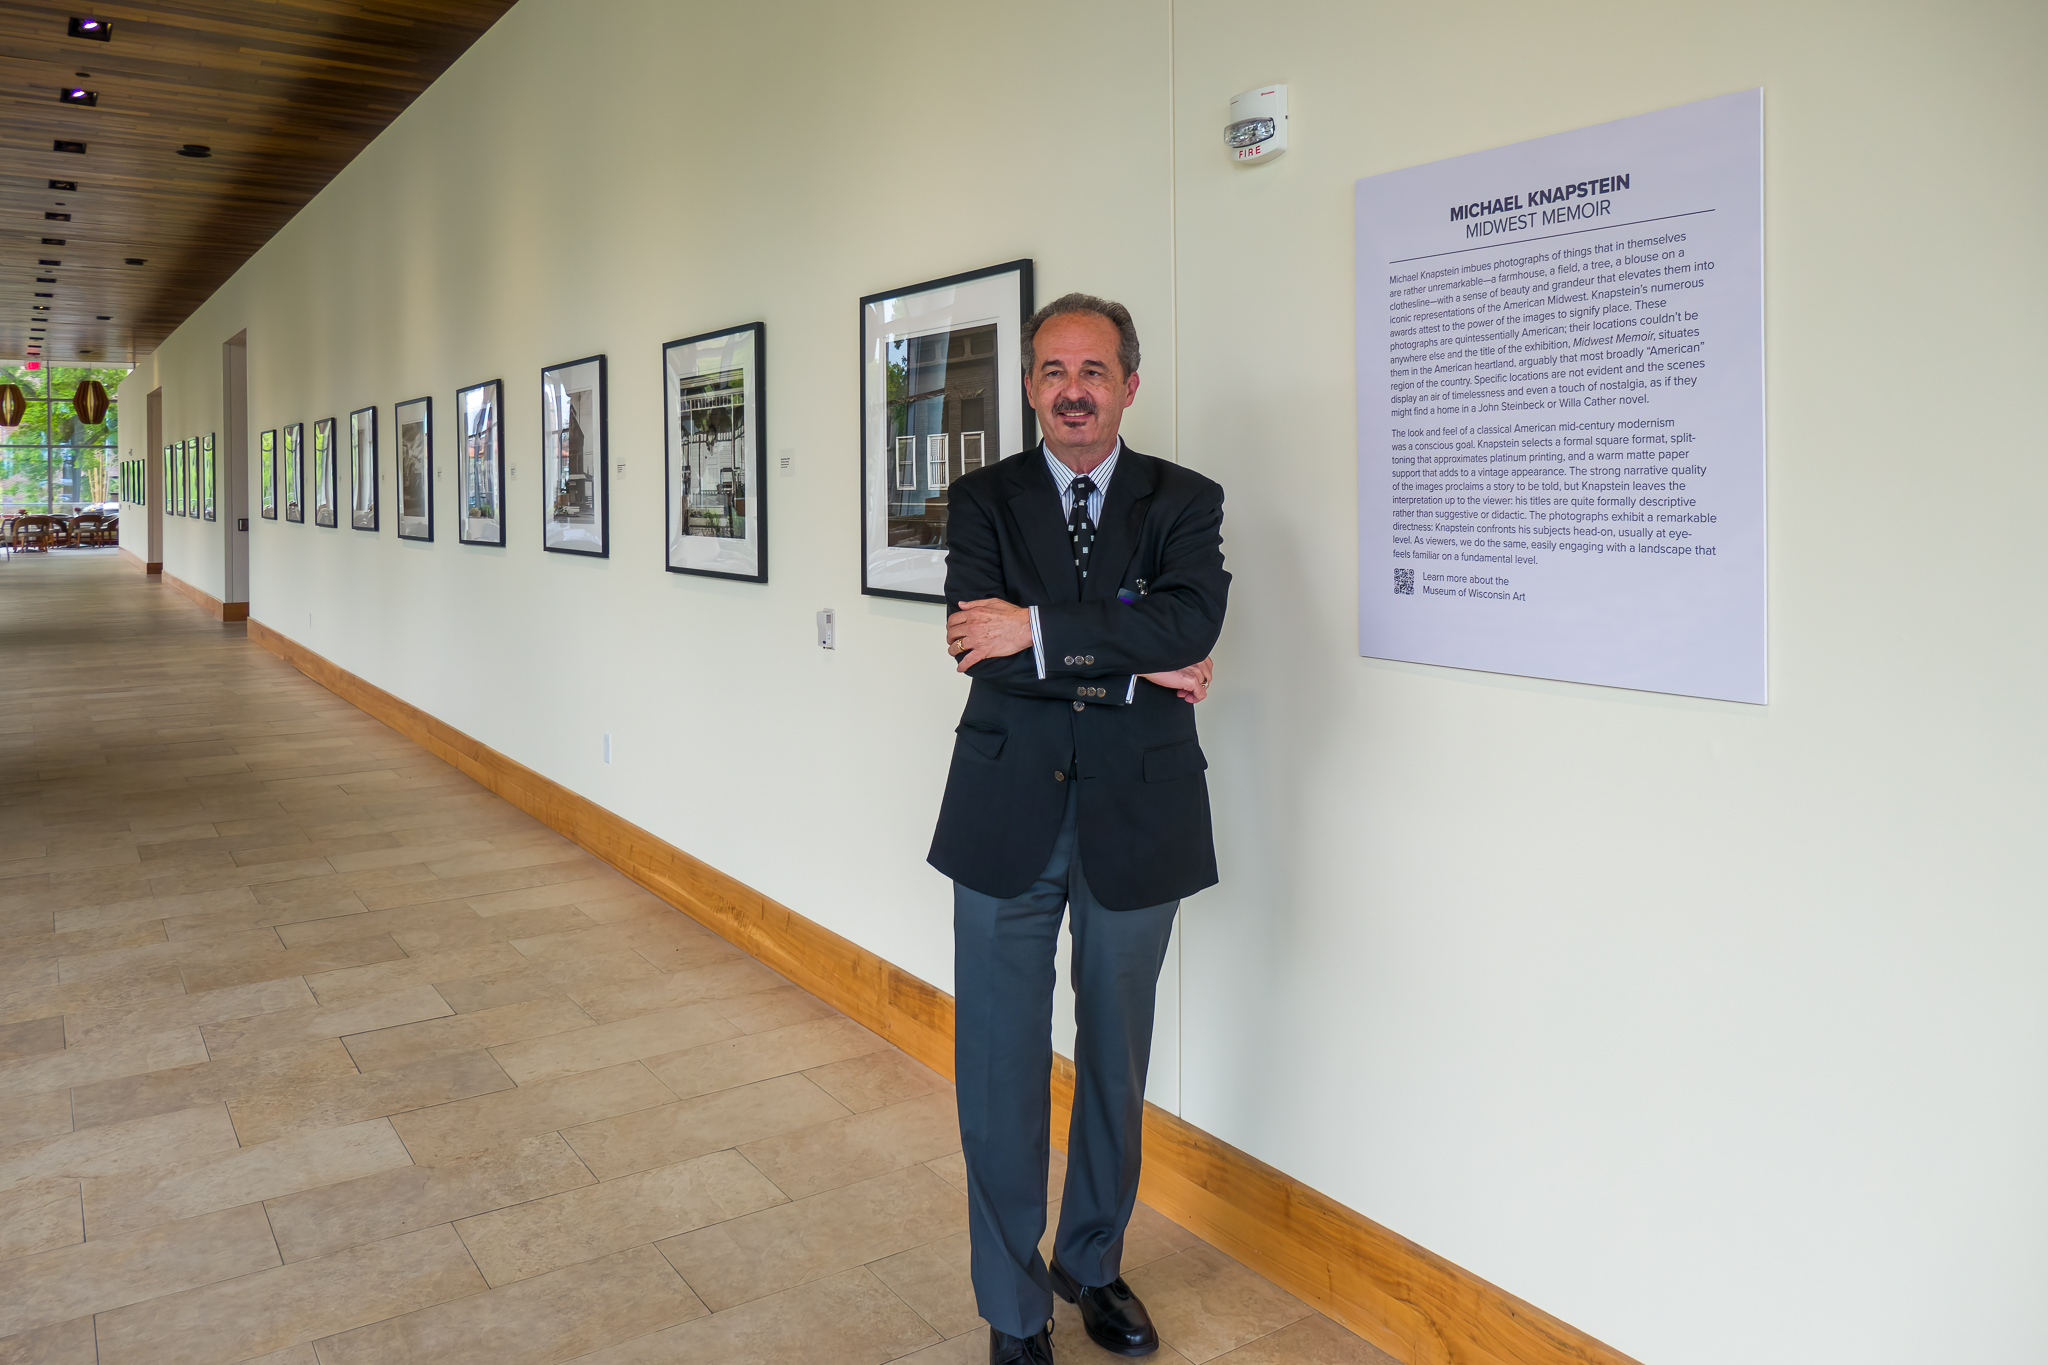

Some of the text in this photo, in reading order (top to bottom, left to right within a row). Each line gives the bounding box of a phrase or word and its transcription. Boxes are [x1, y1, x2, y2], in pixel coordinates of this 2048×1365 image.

[1238, 145, 1261, 158] FIRE
[1450, 173, 1630, 222] MICHAEL KNAPSTEIN
[1466, 199, 1611, 239] MIDWEST MEMOIR
[1389, 233, 1687, 284] Michael Knapstein imbues photographs things that themselves
[1403, 285, 1426, 296] rather
[1498, 269, 1547, 282] farmhouse,
[1557, 262, 1580, 274] field,
[1590, 260, 1613, 270] tree,
[1624, 253, 1659, 265] blouse
[1462, 291, 1488, 302] sense
[1500, 285, 1530, 297] beauty
[1551, 277, 1595, 292] grandeur
[1596, 273, 1616, 284] that
[1618, 268, 1661, 281] elevates
[1664, 264, 1691, 276] them
[1694, 261, 1715, 272] into
[1389, 313, 1412, 324] iconic
[1413, 307, 1475, 322] representations
[1502, 298, 1545, 311] American
[1547, 292, 1589, 305] Midwest.
[1650, 279, 1704, 293] numerous
[1389, 299, 1667, 338] awards attest power images signify place. These
[1390, 338, 1438, 352] photographs
[1454, 329, 1520, 346] quintessentially
[1521, 325, 1567, 337] American;
[1569, 321, 1591, 332] their
[1593, 318, 1637, 330] locations
[1390, 328, 1700, 365] anywhere else title exhibition, Midwest Memoir, situates
[1390, 368, 1410, 377] them
[1434, 363, 1472, 374] American
[1474, 358, 1517, 370] heartland,
[1518, 354, 1558, 368] arguably
[1559, 353, 1578, 363] that
[1580, 351, 1604, 361] most
[1606, 347, 1644, 360] broadly
[1390, 360, 1705, 392] region country. Specific locations evident scenes
[1390, 375, 1698, 405] display timelessness even touch nostalgia, they
[1391, 393, 1649, 419] might home John Steinbeck Willa Cather novel.
[1476, 417, 1675, 434] classical American mid-century modernism
[1414, 432, 1696, 452] conscious goal. Knapstein selects formal square format, split-
[1391, 450, 1690, 466] toning approximates platinum printing, warm matte paper
[1391, 464, 1707, 479] support adds vintage appearance. strong narrative quality
[1415, 480, 1666, 493] images proclaims story told, Knapstein leaves
[1392, 495, 1696, 508] interpretation viewer: titles quite formally descriptive
[1392, 508, 1717, 523] rather than suggestive didactic. photographs exhibit remarkable
[1392, 521, 1654, 540] directness: Knapstein confronts subjects head-on, usually
[1392, 535, 1716, 556] level. viewers, same, easily engaging with landscape that
[1392, 548, 1538, 565] feels familiar fundamental level.
[1422, 572, 1509, 586] Learn more about the
[1422, 585, 1526, 602] Museum of Wisconsin Art
